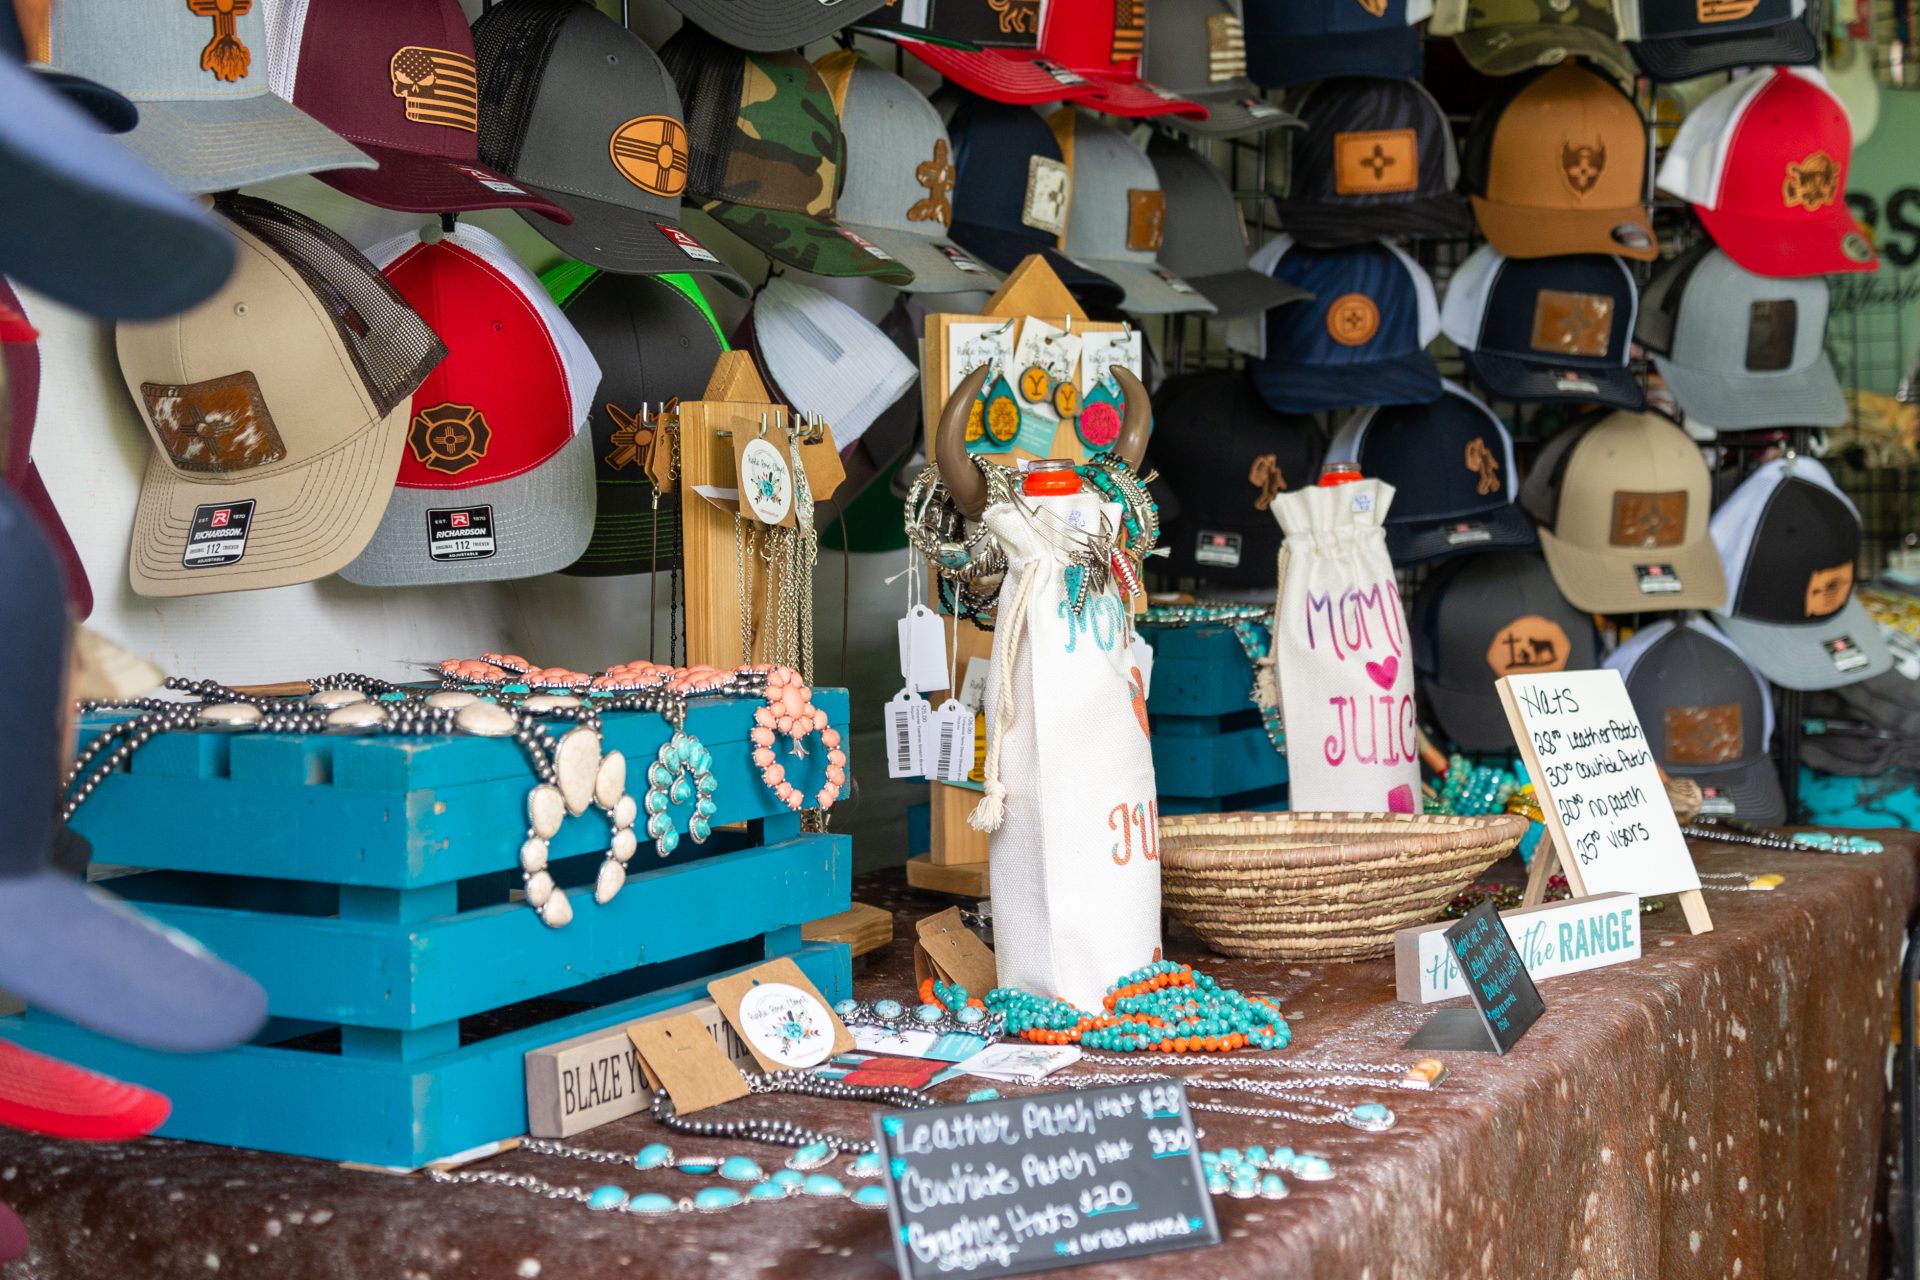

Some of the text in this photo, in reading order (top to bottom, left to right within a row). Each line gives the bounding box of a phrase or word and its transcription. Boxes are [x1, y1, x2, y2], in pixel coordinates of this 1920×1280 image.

[193, 527, 243, 541] RICHARDSON
[206, 543, 222, 555] 112
[436, 527, 487, 539] RICHARDSON
[455, 540, 470, 551] 112
[1519, 684, 1580, 718] Hats
[1324, 694, 1417, 767] JUIC
[1588, 797, 1609, 819] no
[1606, 820, 1651, 850] visors
[1517, 919, 1557, 972] the
[1558, 908, 1635, 963] RANGE
[1425, 938, 1461, 991] Ho
[563, 1054, 624, 1117] BLAZE
[897, 1085, 1180, 1155] Leather Patch Hat $28
[901, 1125, 1192, 1213] Cowhide Patch Hat $30
[1004, 1202, 1079, 1244] Hats
[1079, 1179, 1133, 1214] $20
